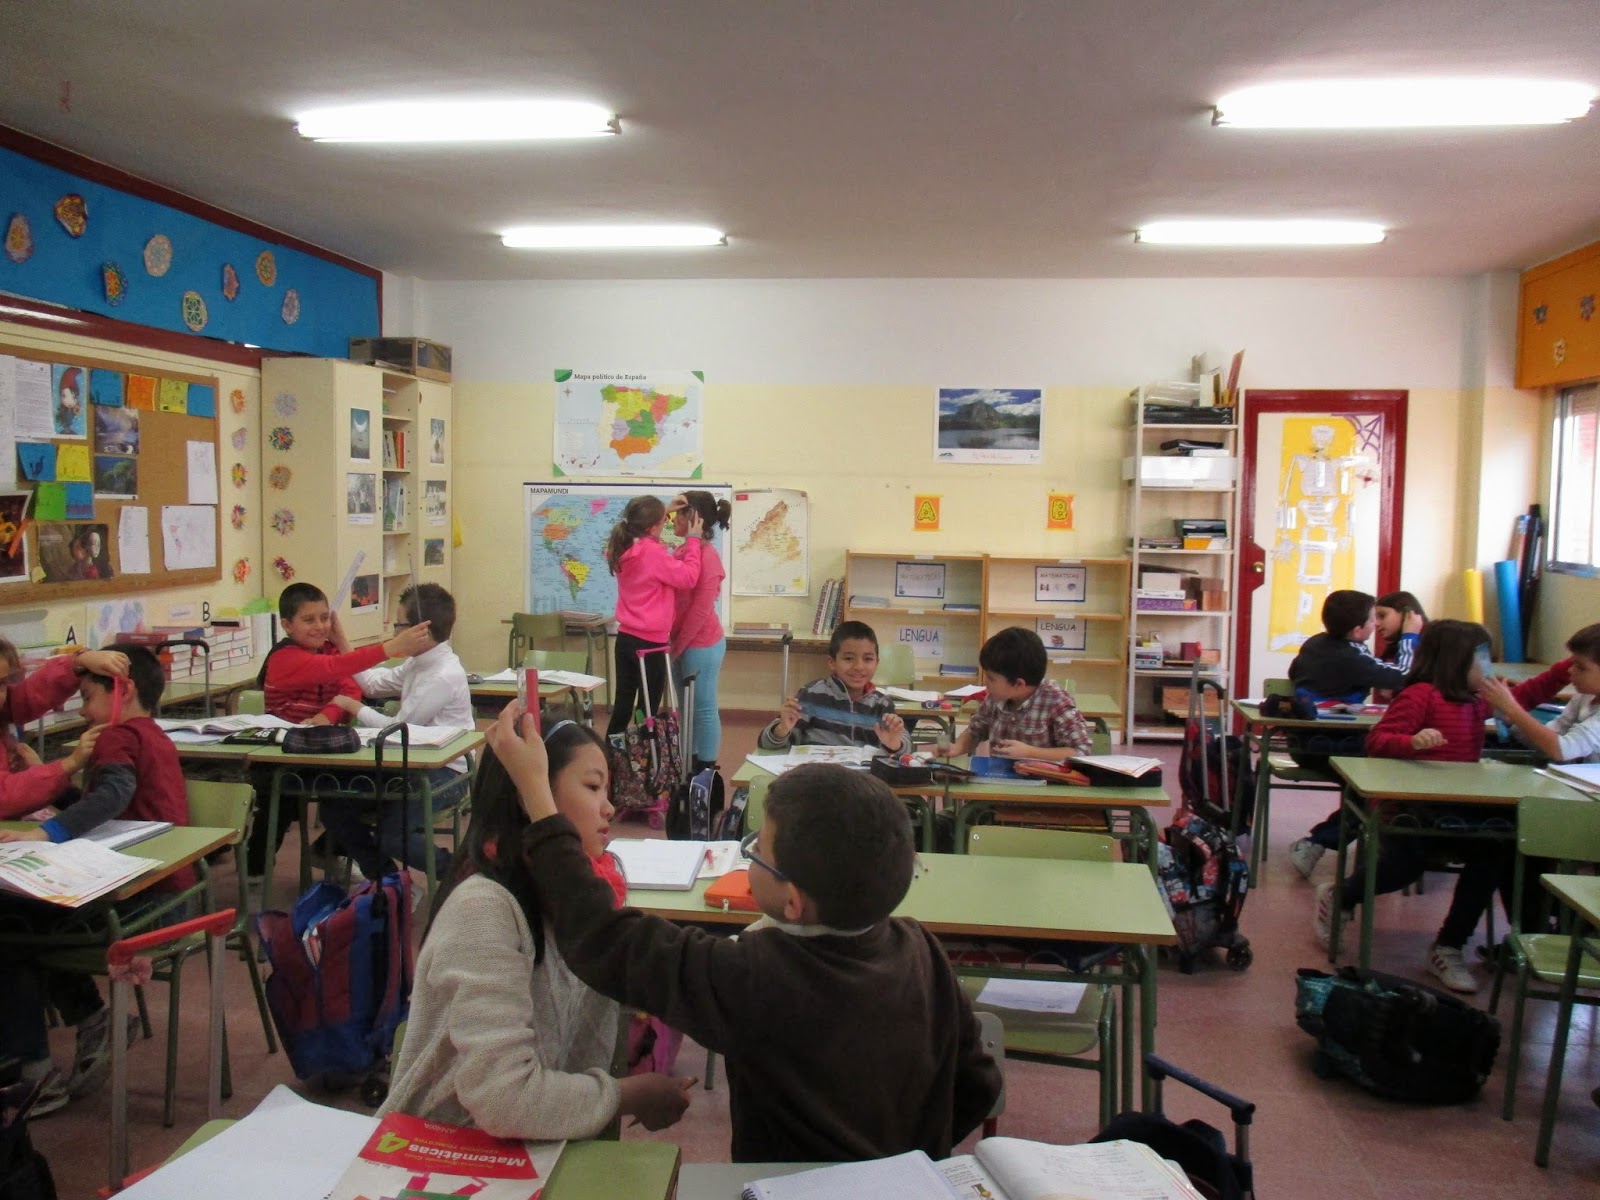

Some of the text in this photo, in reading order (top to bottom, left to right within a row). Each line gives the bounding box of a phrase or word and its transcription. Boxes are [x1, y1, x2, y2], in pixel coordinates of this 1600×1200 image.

[574, 373, 591, 381] Mapa
[624, 373, 647, 381] España
[916, 501, 937, 522] A
[1051, 498, 1069, 521] B
[202, 601, 211, 622] B
[65, 625, 77, 645] A
[899, 628, 940, 642] LENGUA
[1040, 621, 1077, 632] LENGUA
[376, 1132, 410, 1154] 4
[408, 1144, 526, 1167] Matemáticas
